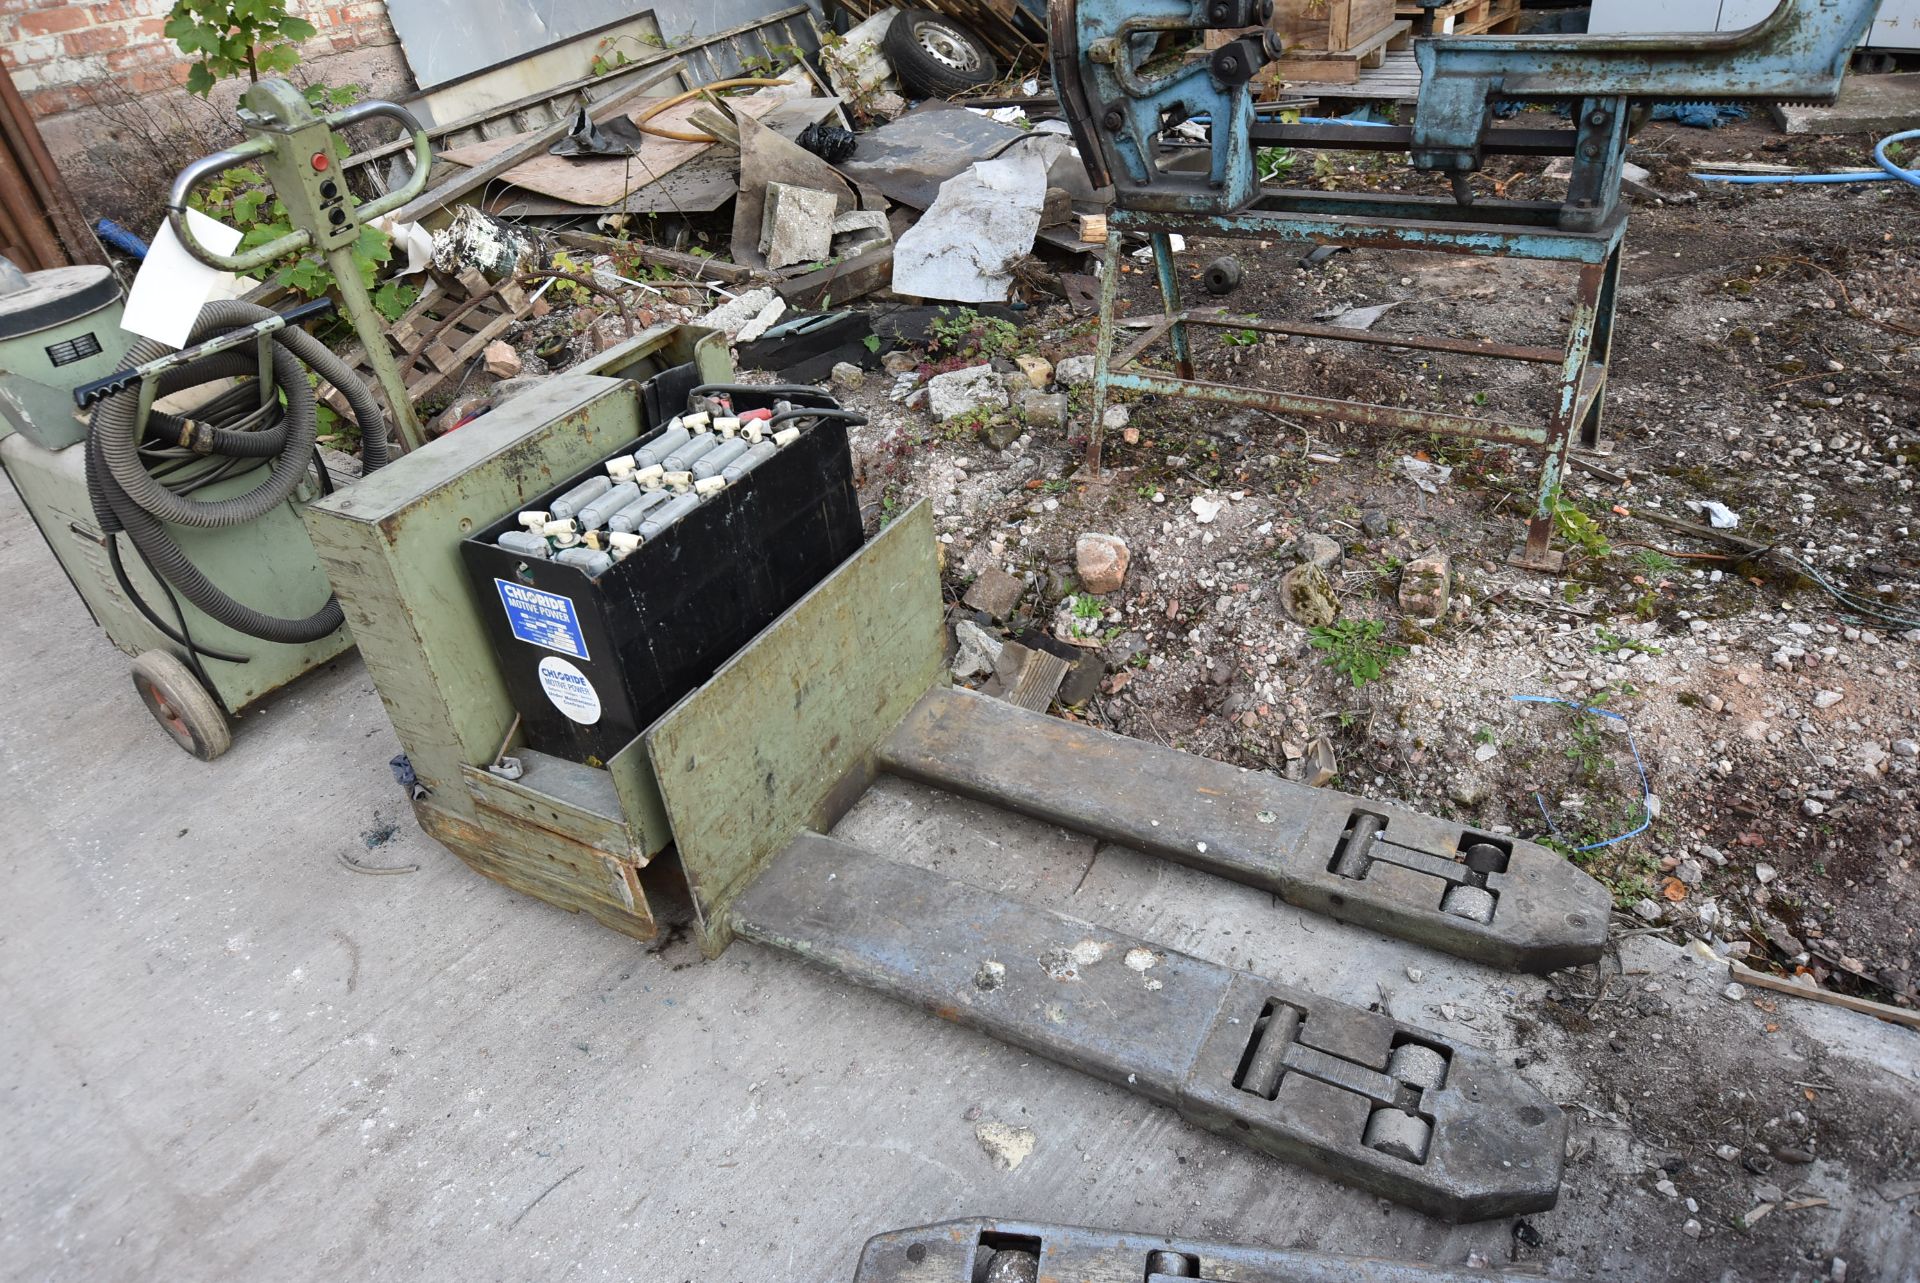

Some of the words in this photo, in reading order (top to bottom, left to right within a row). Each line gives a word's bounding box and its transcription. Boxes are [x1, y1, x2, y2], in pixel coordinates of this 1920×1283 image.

[504, 585, 566, 612] CHLORIDE
[508, 598, 539, 613] MOTIVE
[539, 606, 570, 622] POWER
[541, 668, 585, 685] CHLORIDE
[545, 677, 567, 689] MOTIVE
[567, 684, 590, 694] POWER
